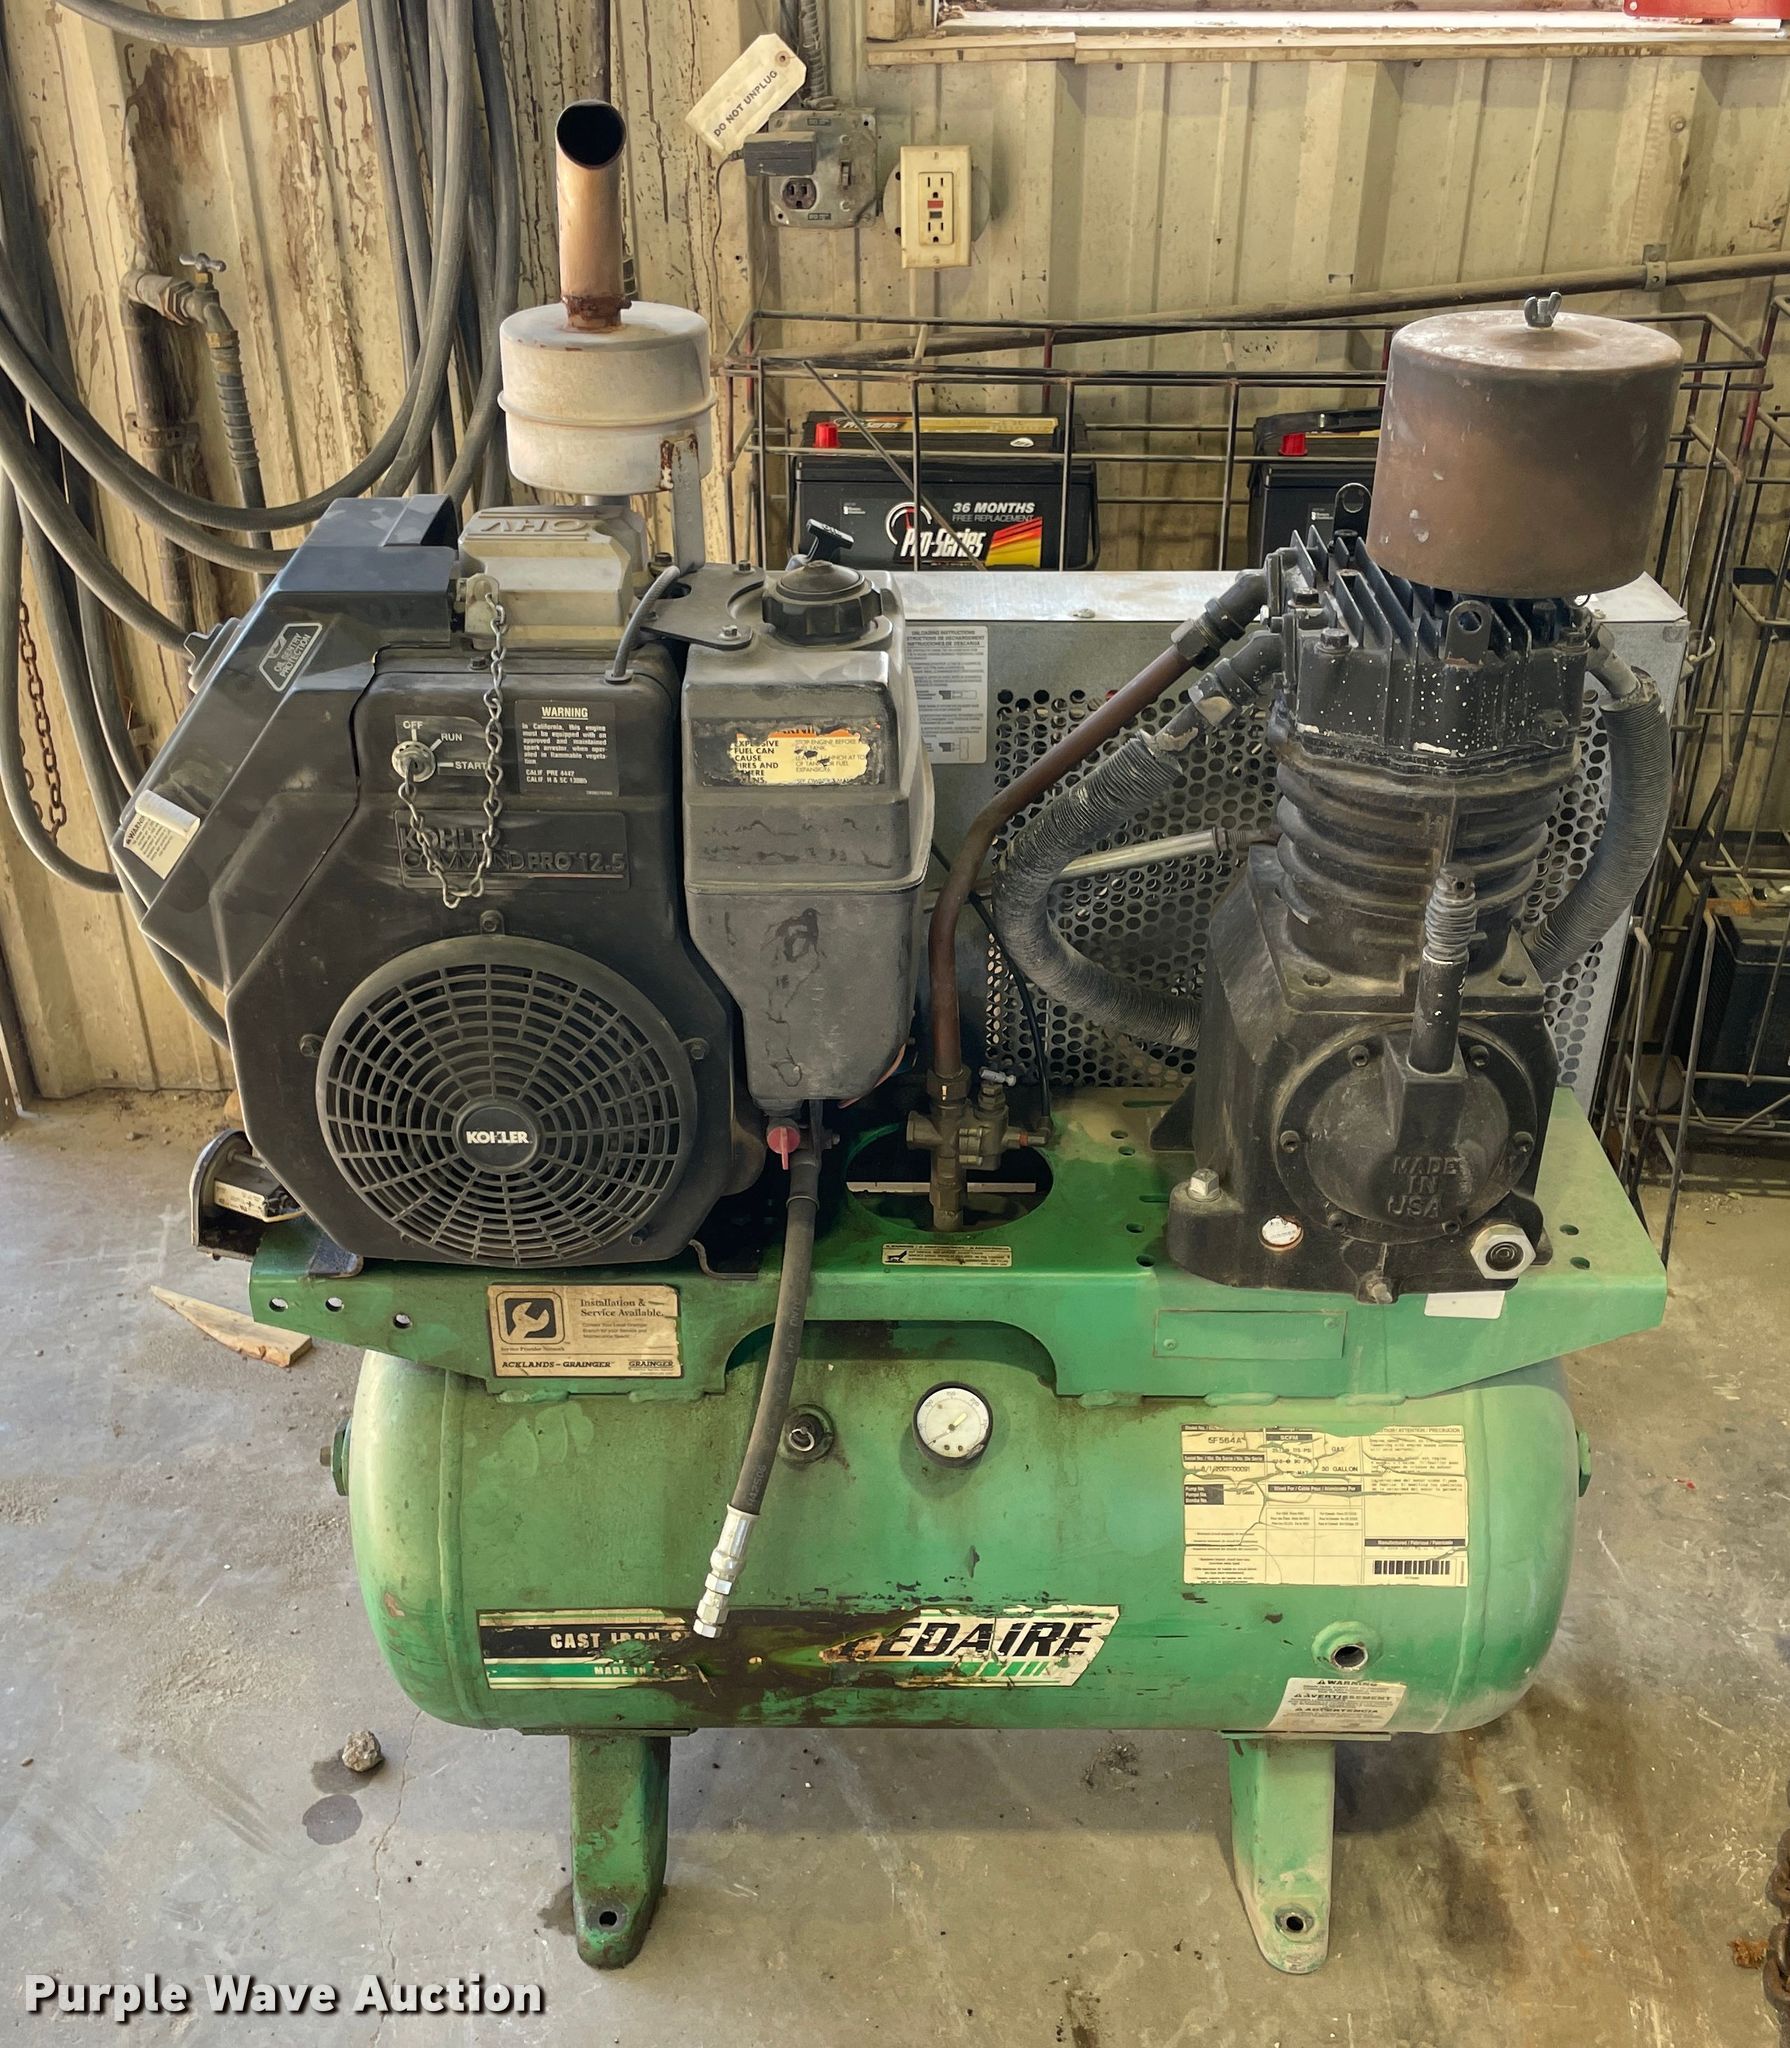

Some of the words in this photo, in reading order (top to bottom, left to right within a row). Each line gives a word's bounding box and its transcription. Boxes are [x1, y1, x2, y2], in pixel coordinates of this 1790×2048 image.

[713, 123, 727, 137] DO
[728, 103, 744, 124] NOT
[743, 70, 778, 105] UNPLUG
[952, 502, 970, 514] 36
[974, 502, 1035, 514] MONTHS
[952, 514, 972, 523] FREE
[974, 514, 1034, 523] REPLACEMENT
[541, 706, 588, 718] WARNING
[403, 720, 423, 730] OFF
[441, 732, 463, 742] RUN
[455, 761, 487, 770] START
[528, 852, 571, 870] PRO
[577, 852, 625, 872] 12.5
[466, 1130, 529, 1145] KOHLER
[1393, 1156, 1457, 1175] MADE
[1408, 1175, 1438, 1194] IN
[1387, 1195, 1439, 1218] USA
[580, 1297, 636, 1307] Installation
[638, 1298, 646, 1307] &
[580, 1308, 616, 1317] Service
[618, 1308, 664, 1317] Available.
[628, 1360, 674, 1368] GRAINGER
[550, 1633, 600, 1649] CAST
[594, 1666, 628, 1675] MADE
